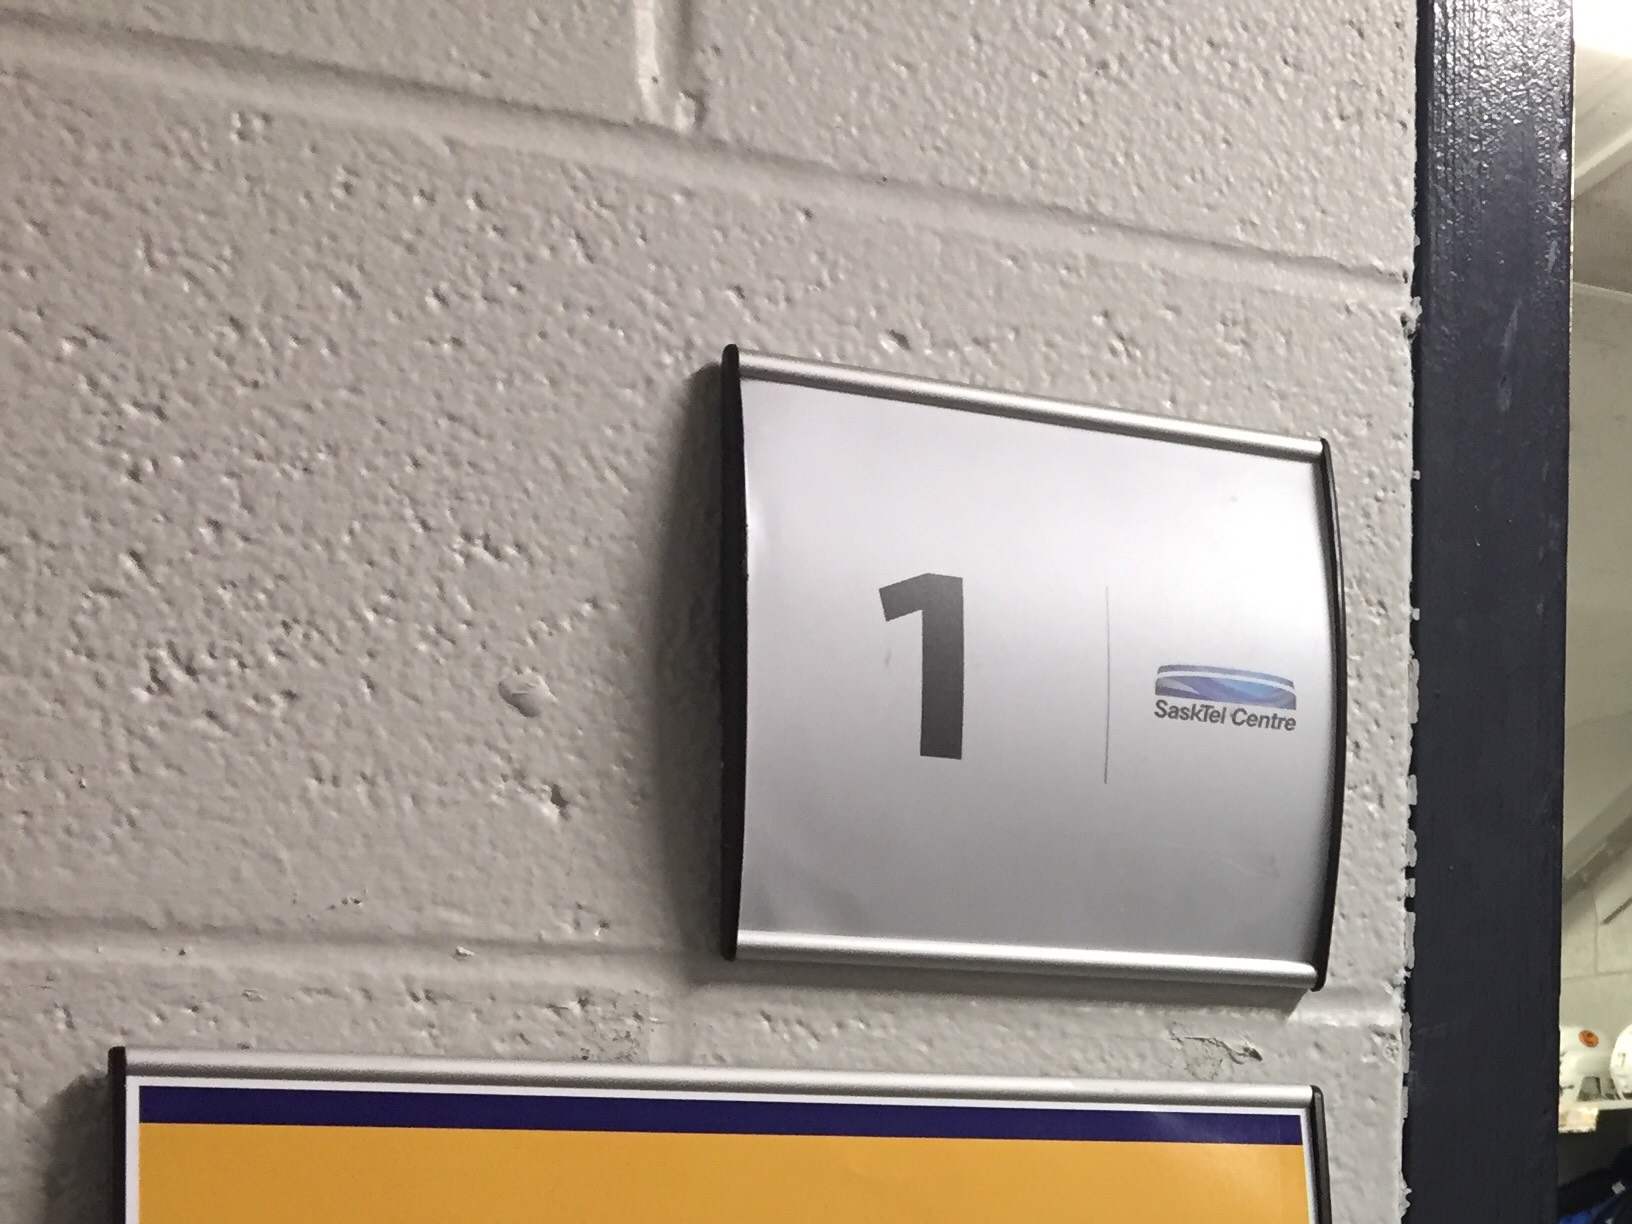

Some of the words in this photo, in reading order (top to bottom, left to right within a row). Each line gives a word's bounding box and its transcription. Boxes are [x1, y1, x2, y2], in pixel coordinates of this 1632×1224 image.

[879, 573, 965, 760] 1
[1154, 699, 1227, 725] SaskTel
[1230, 708, 1297, 731] Centre
